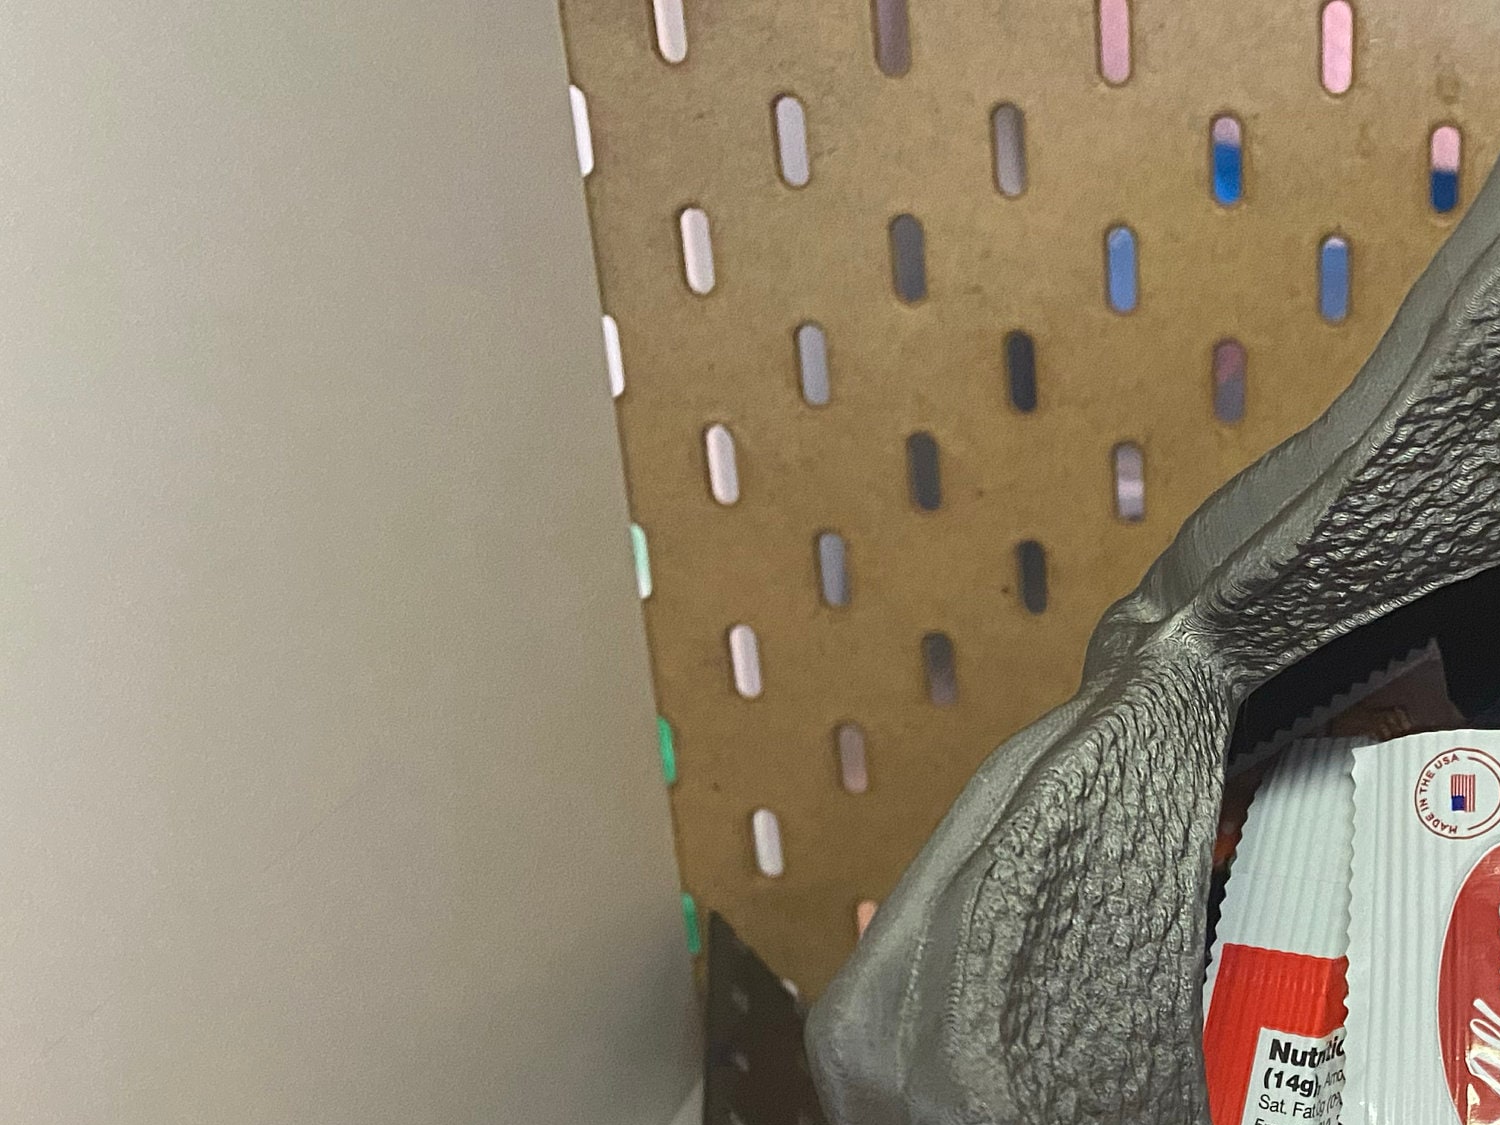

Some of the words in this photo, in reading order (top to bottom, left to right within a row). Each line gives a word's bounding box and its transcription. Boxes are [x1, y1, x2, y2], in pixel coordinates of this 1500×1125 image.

[1434, 753, 1460, 770] USA
[1419, 771, 1436, 796] THE
[1419, 797, 1429, 812] IN
[1425, 813, 1458, 834] MADE
[1258, 1093, 1288, 1116] Sat.
[1292, 1101, 1316, 1119] Fat
